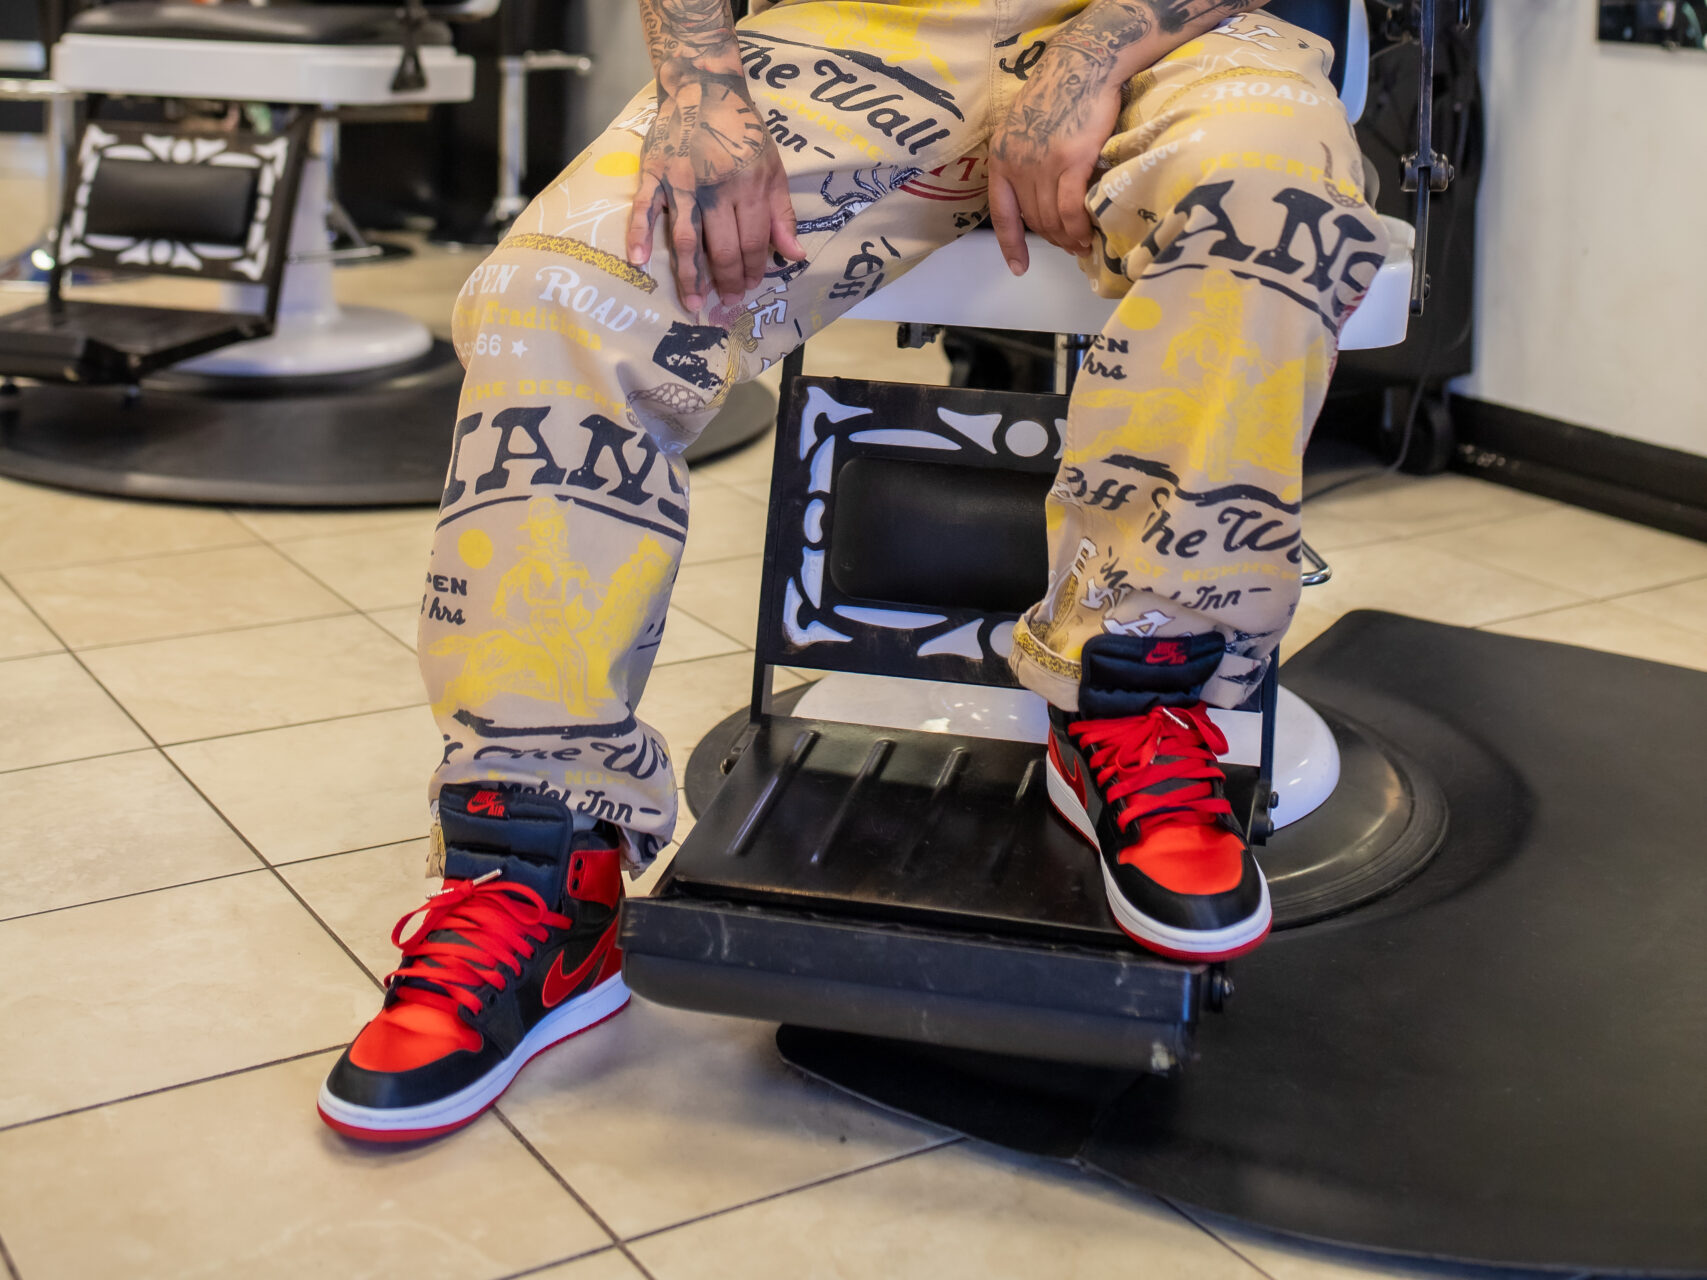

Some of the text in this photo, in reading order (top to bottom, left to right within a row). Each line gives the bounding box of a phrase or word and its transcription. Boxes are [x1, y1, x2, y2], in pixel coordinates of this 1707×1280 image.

[809, 59, 951, 156] Wall
[676, 104, 699, 158] NOTHINGS
[455, 264, 520, 298] PEN
[464, 380, 508, 403] THE
